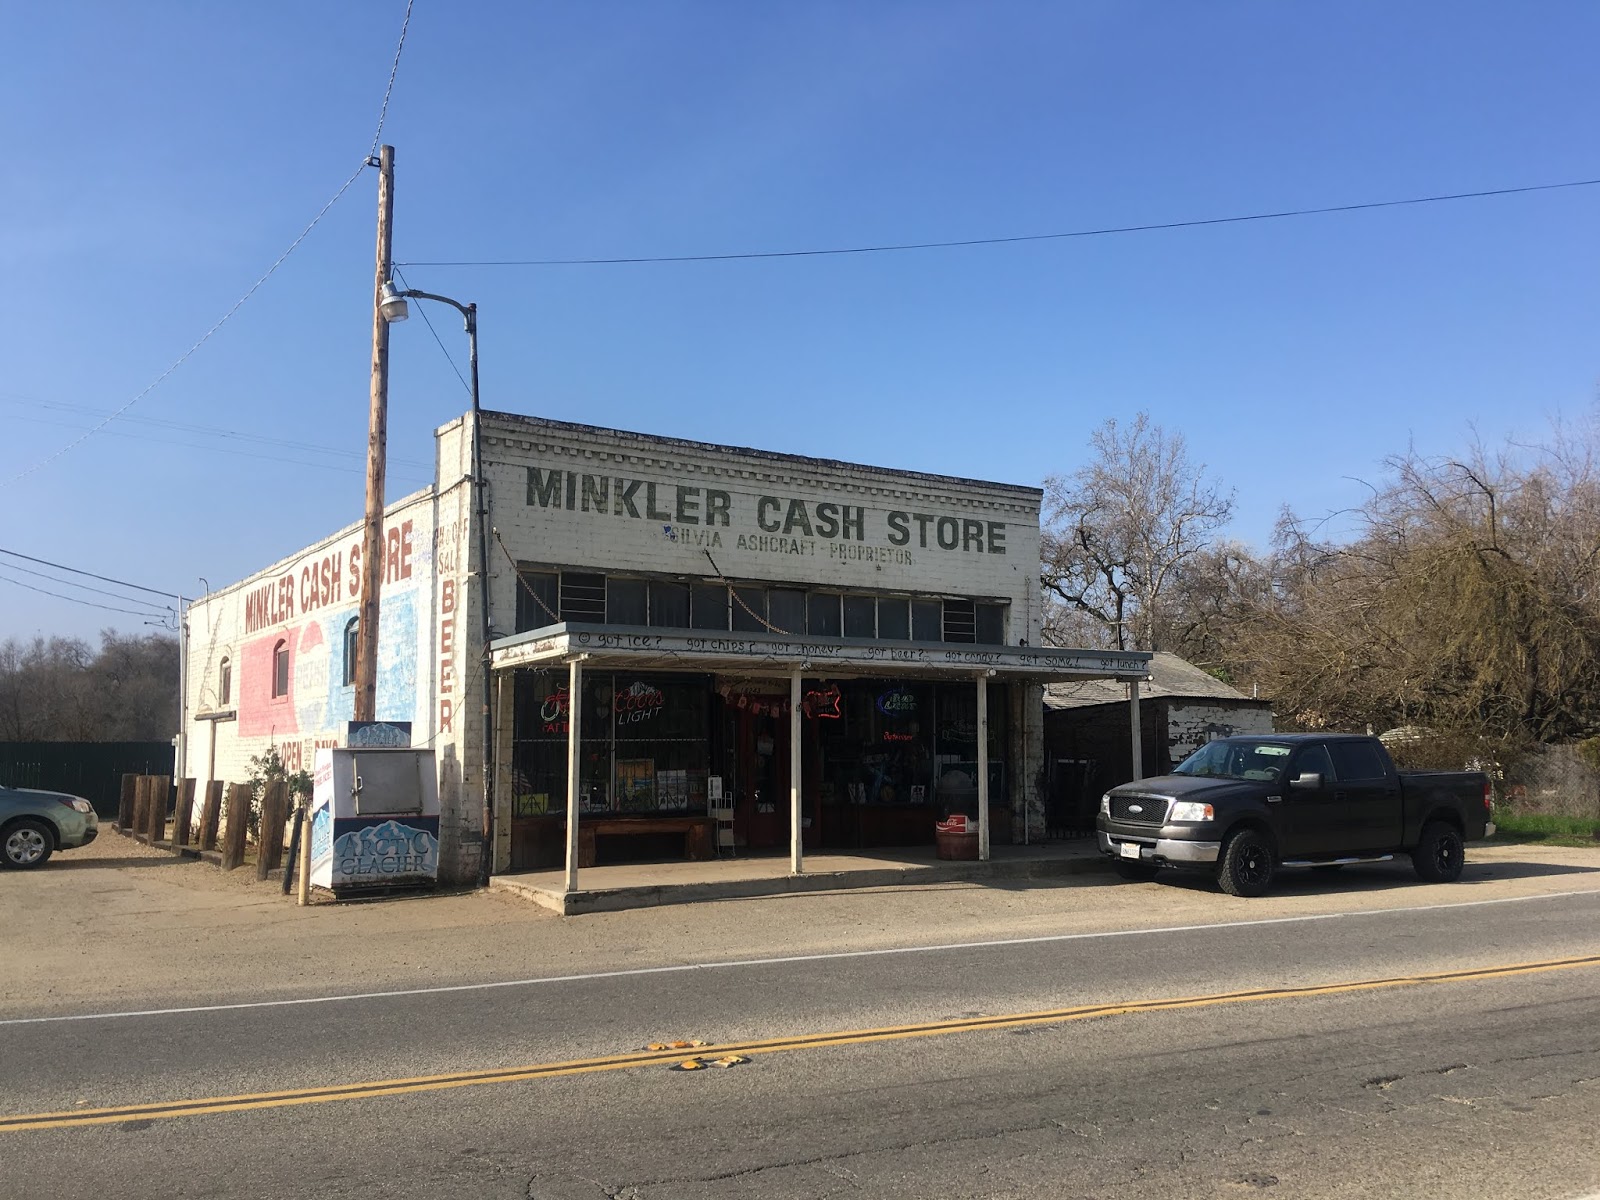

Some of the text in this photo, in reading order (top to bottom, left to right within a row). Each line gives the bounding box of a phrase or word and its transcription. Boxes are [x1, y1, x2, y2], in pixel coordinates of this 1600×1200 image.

[526, 467, 1006, 555] MINKLER CASH STORE
[671, 527, 914, 566] SILVIA ASHCRAFT PROPRIETOR
[245, 518, 413, 635] MINKLER CASH SRE
[440, 579, 455, 734] BEER
[598, 634, 623, 648] got
[628, 634, 662, 650] ice?
[687, 638, 708, 651] got
[711, 639, 756, 654] chips?
[771, 642, 790, 654] got
[868, 647, 887, 660] got
[891, 648, 924, 661] beer?
[945, 651, 961, 663] got
[1100, 659, 1113, 670] got
[1117, 659, 1147, 670] lunch?
[614, 688, 664, 713] Coors
[618, 706, 662, 725] LIGHT
[282, 741, 302, 771] OPEN
[340, 831, 429, 858] ARCTIC
[340, 855, 428, 875] GLACIER
